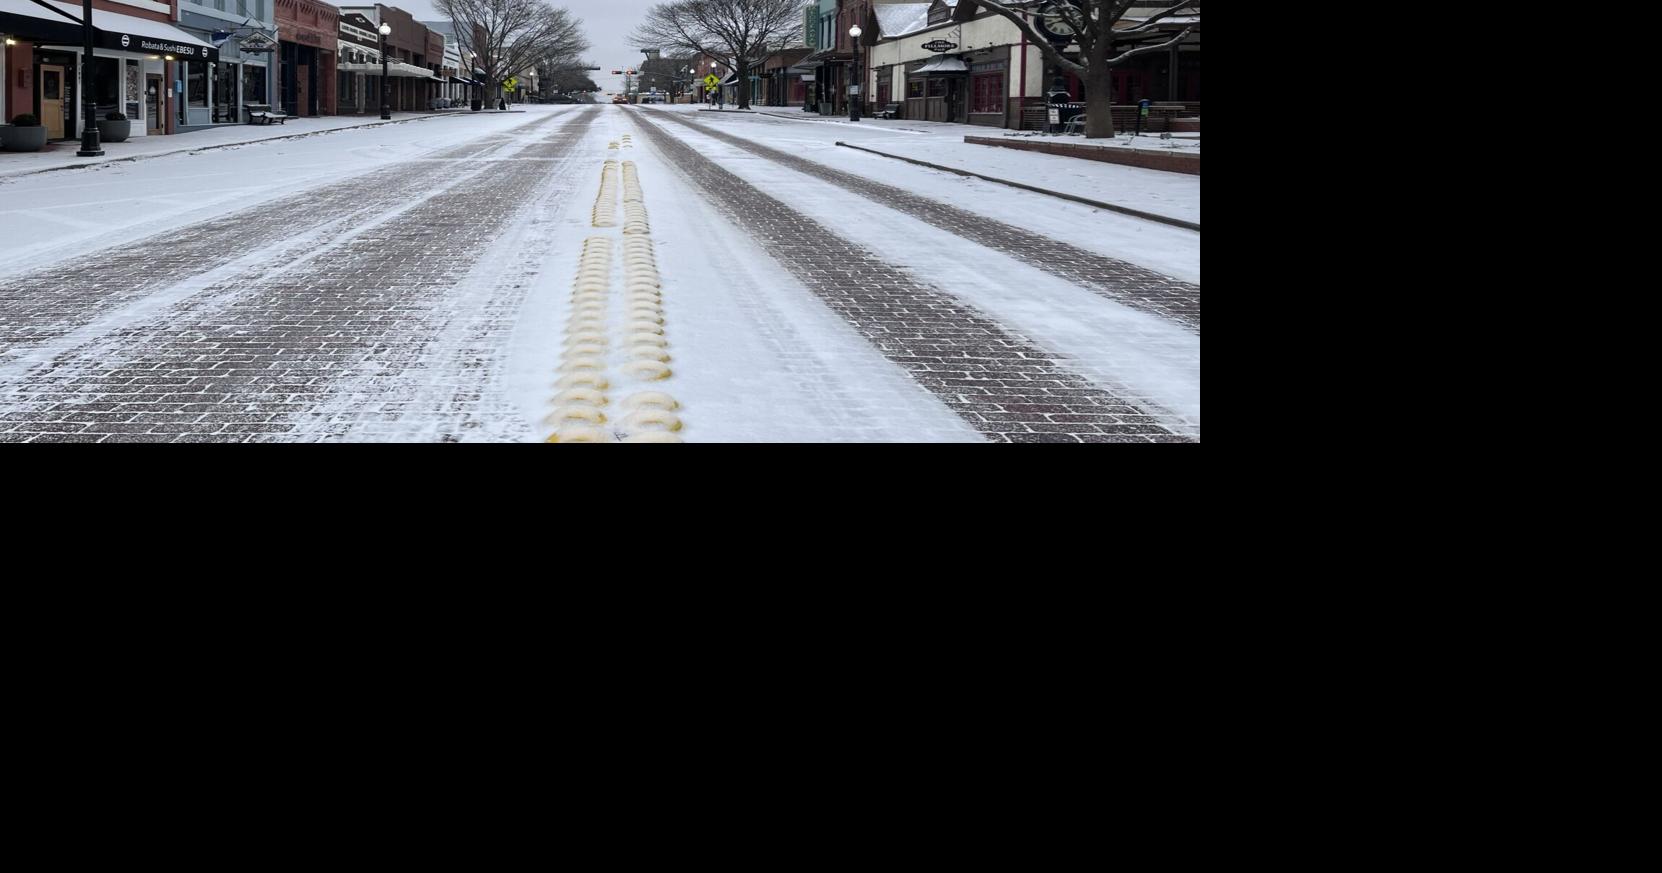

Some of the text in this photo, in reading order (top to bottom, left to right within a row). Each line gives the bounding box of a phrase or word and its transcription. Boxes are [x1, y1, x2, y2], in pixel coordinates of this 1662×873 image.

[141, 40, 160, 50] Robata
[164, 43, 176, 52] Sushi
[176, 45, 194, 55] EBESU
